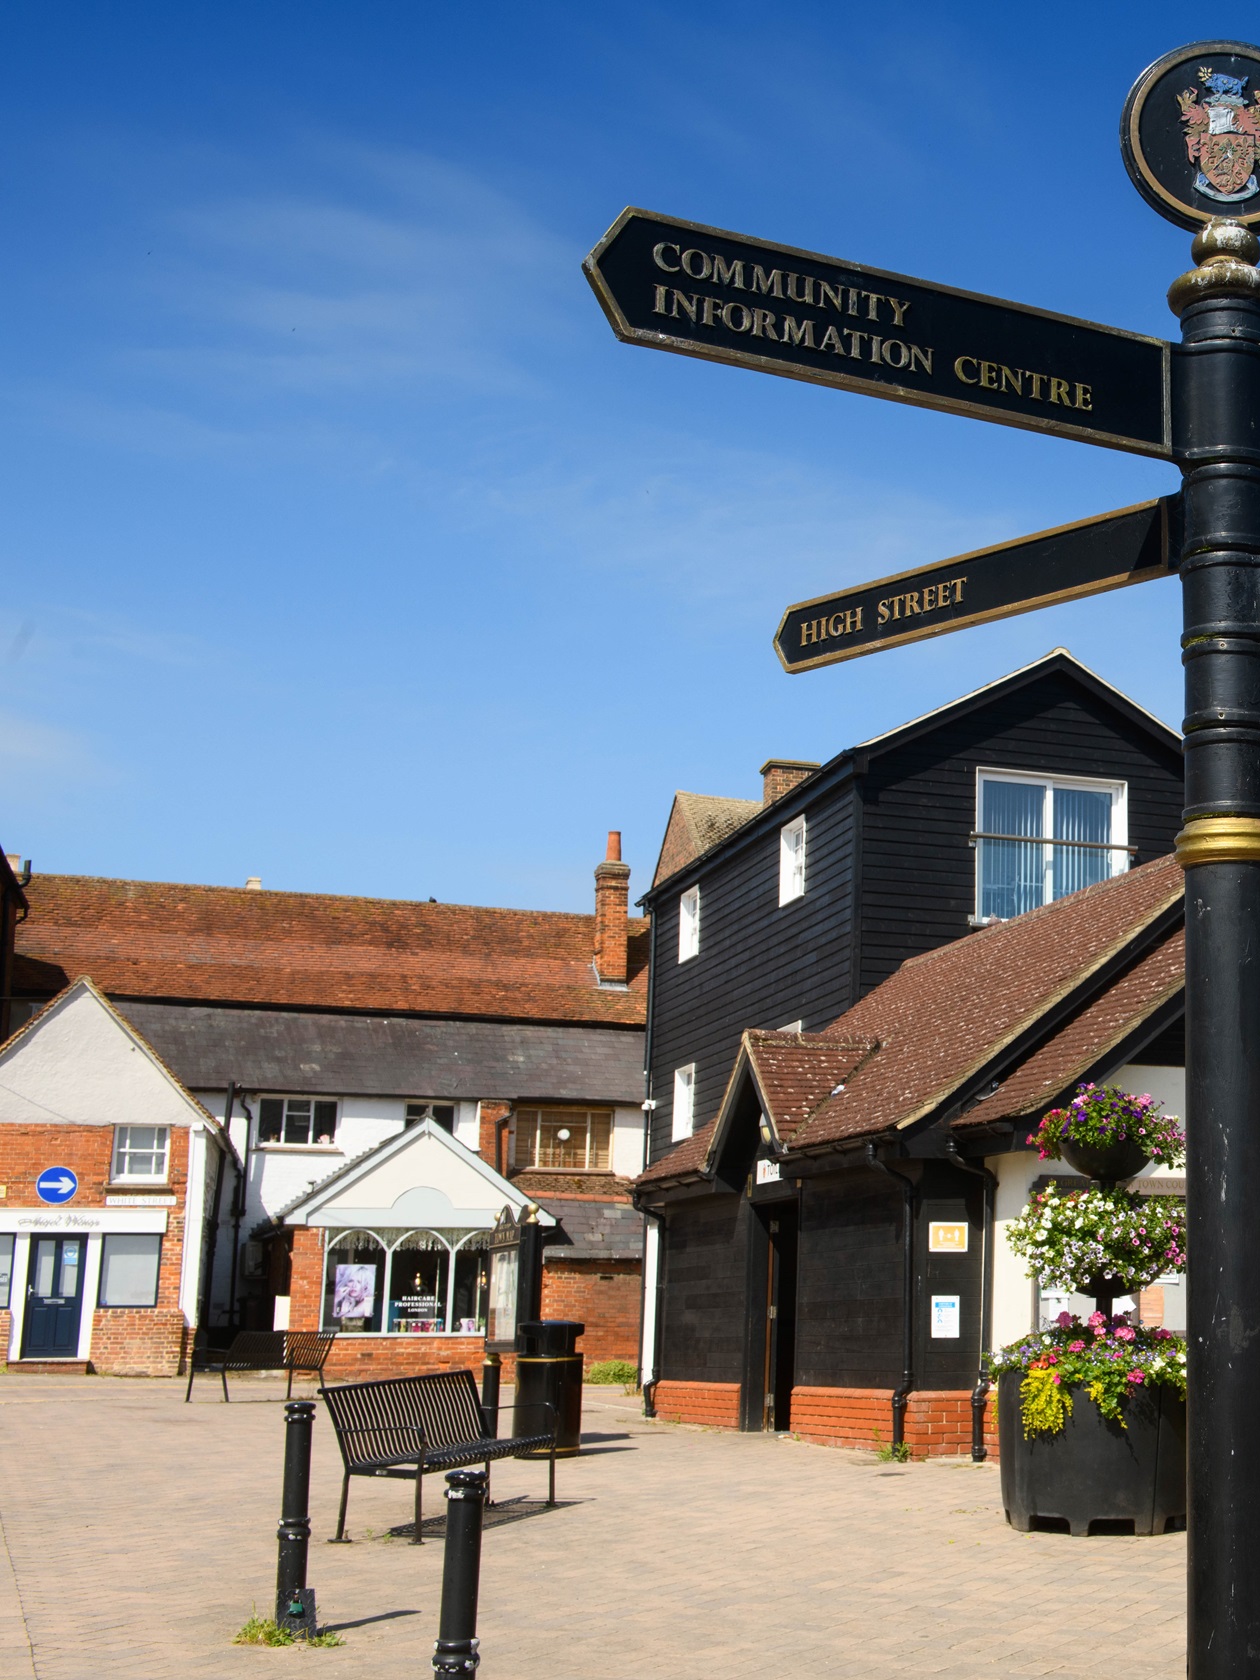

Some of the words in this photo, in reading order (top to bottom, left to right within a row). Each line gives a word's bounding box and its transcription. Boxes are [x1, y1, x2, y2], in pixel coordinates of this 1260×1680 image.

[652, 241, 912, 327] COMMUNITY
[652, 283, 935, 376] INFORMATION
[953, 355, 1093, 412] CENTRE
[800, 606, 864, 648] HIGH
[877, 576, 968, 626] STREET
[1138, 1180, 1164, 1190] TOWN
